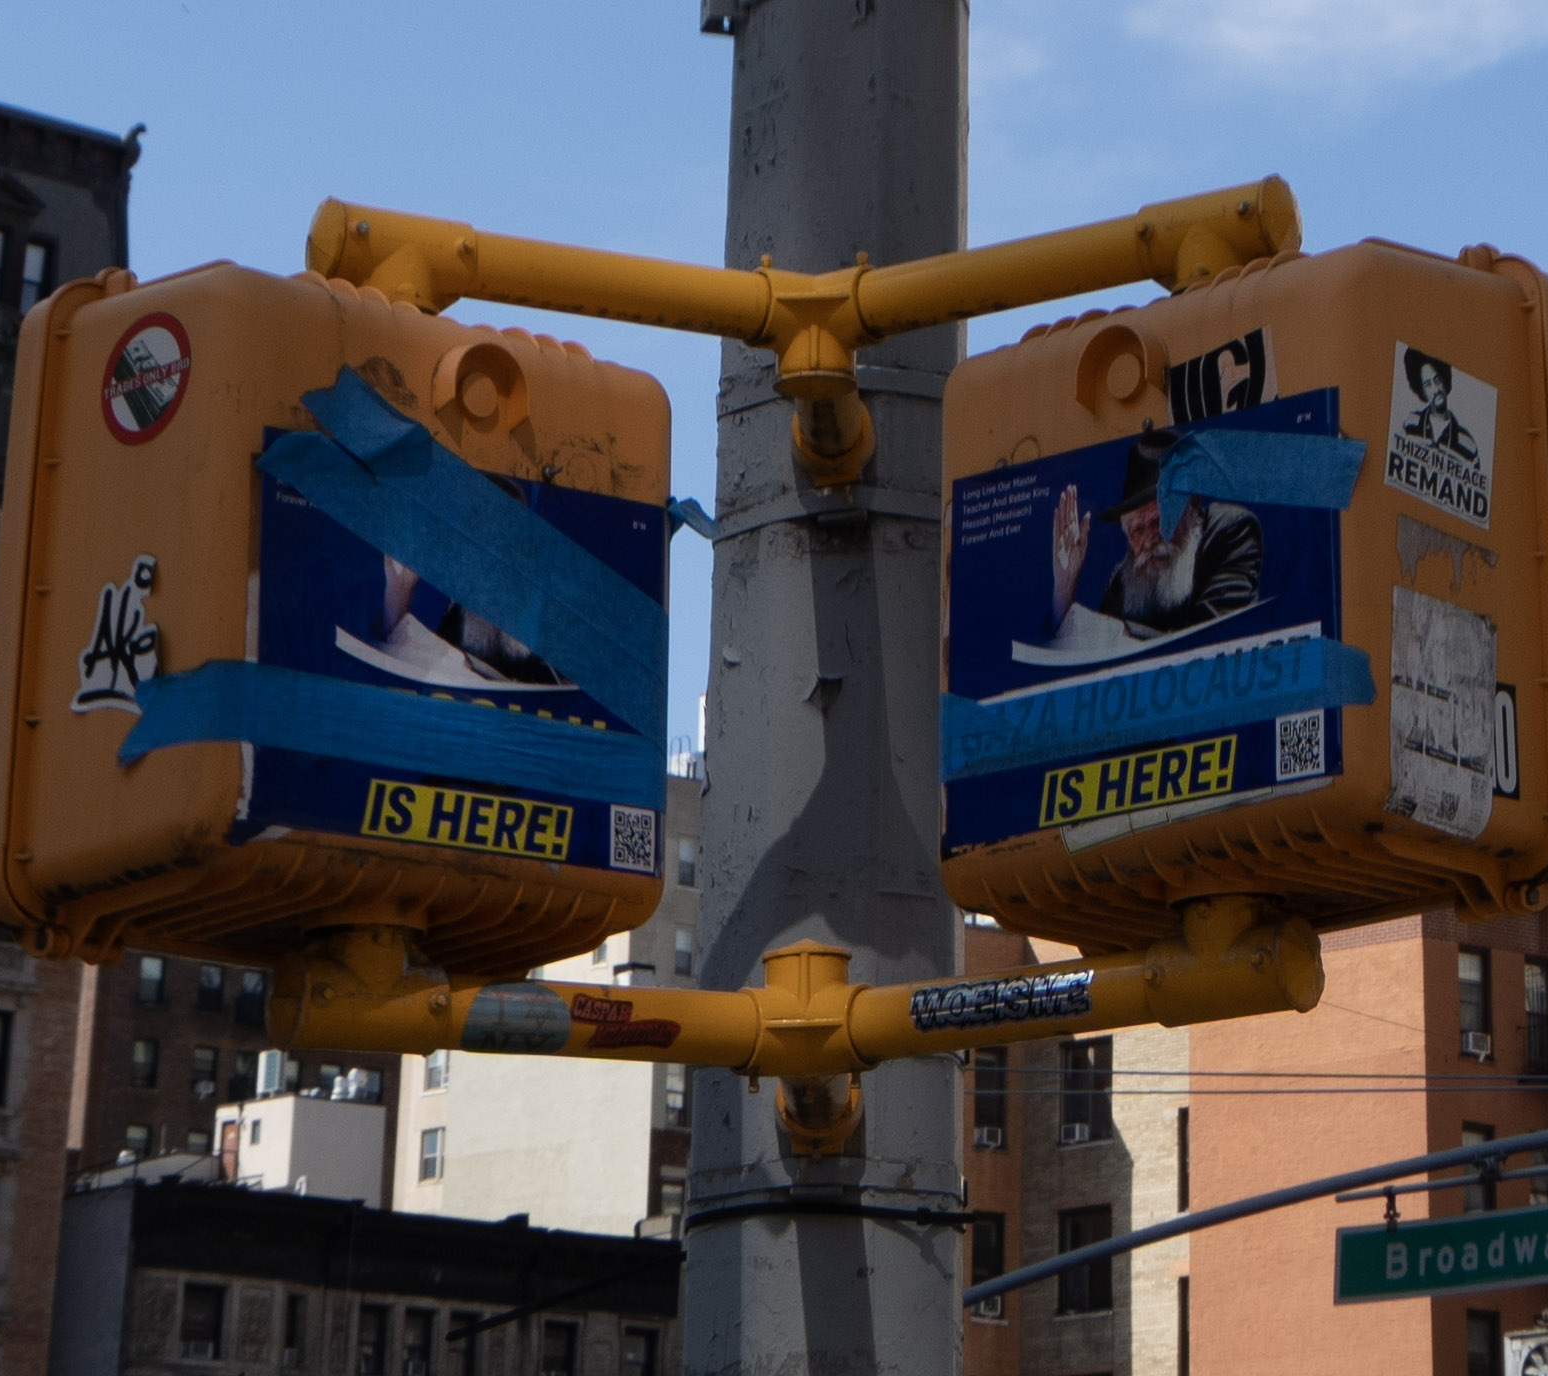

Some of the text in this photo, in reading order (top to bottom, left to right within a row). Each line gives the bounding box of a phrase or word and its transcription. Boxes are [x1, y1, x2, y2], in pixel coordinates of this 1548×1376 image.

[142, 365, 168, 387] ONLY
[170, 356, 190, 376] BRO
[1394, 434, 1487, 490] THIZZ IN PEACE
[963, 475, 1037, 500] Long Live Our Master
[963, 487, 1050, 515] Teacher And Rebbe King
[1388, 451, 1488, 518] REMAND
[961, 524, 1021, 545] Forever And Ever
[962, 516, 990, 529] Messiah
[1072, 635, 1310, 733] HOLOCAUST
[1044, 738, 1233, 822] IS HERE!
[368, 782, 568, 856] IS HERE!
